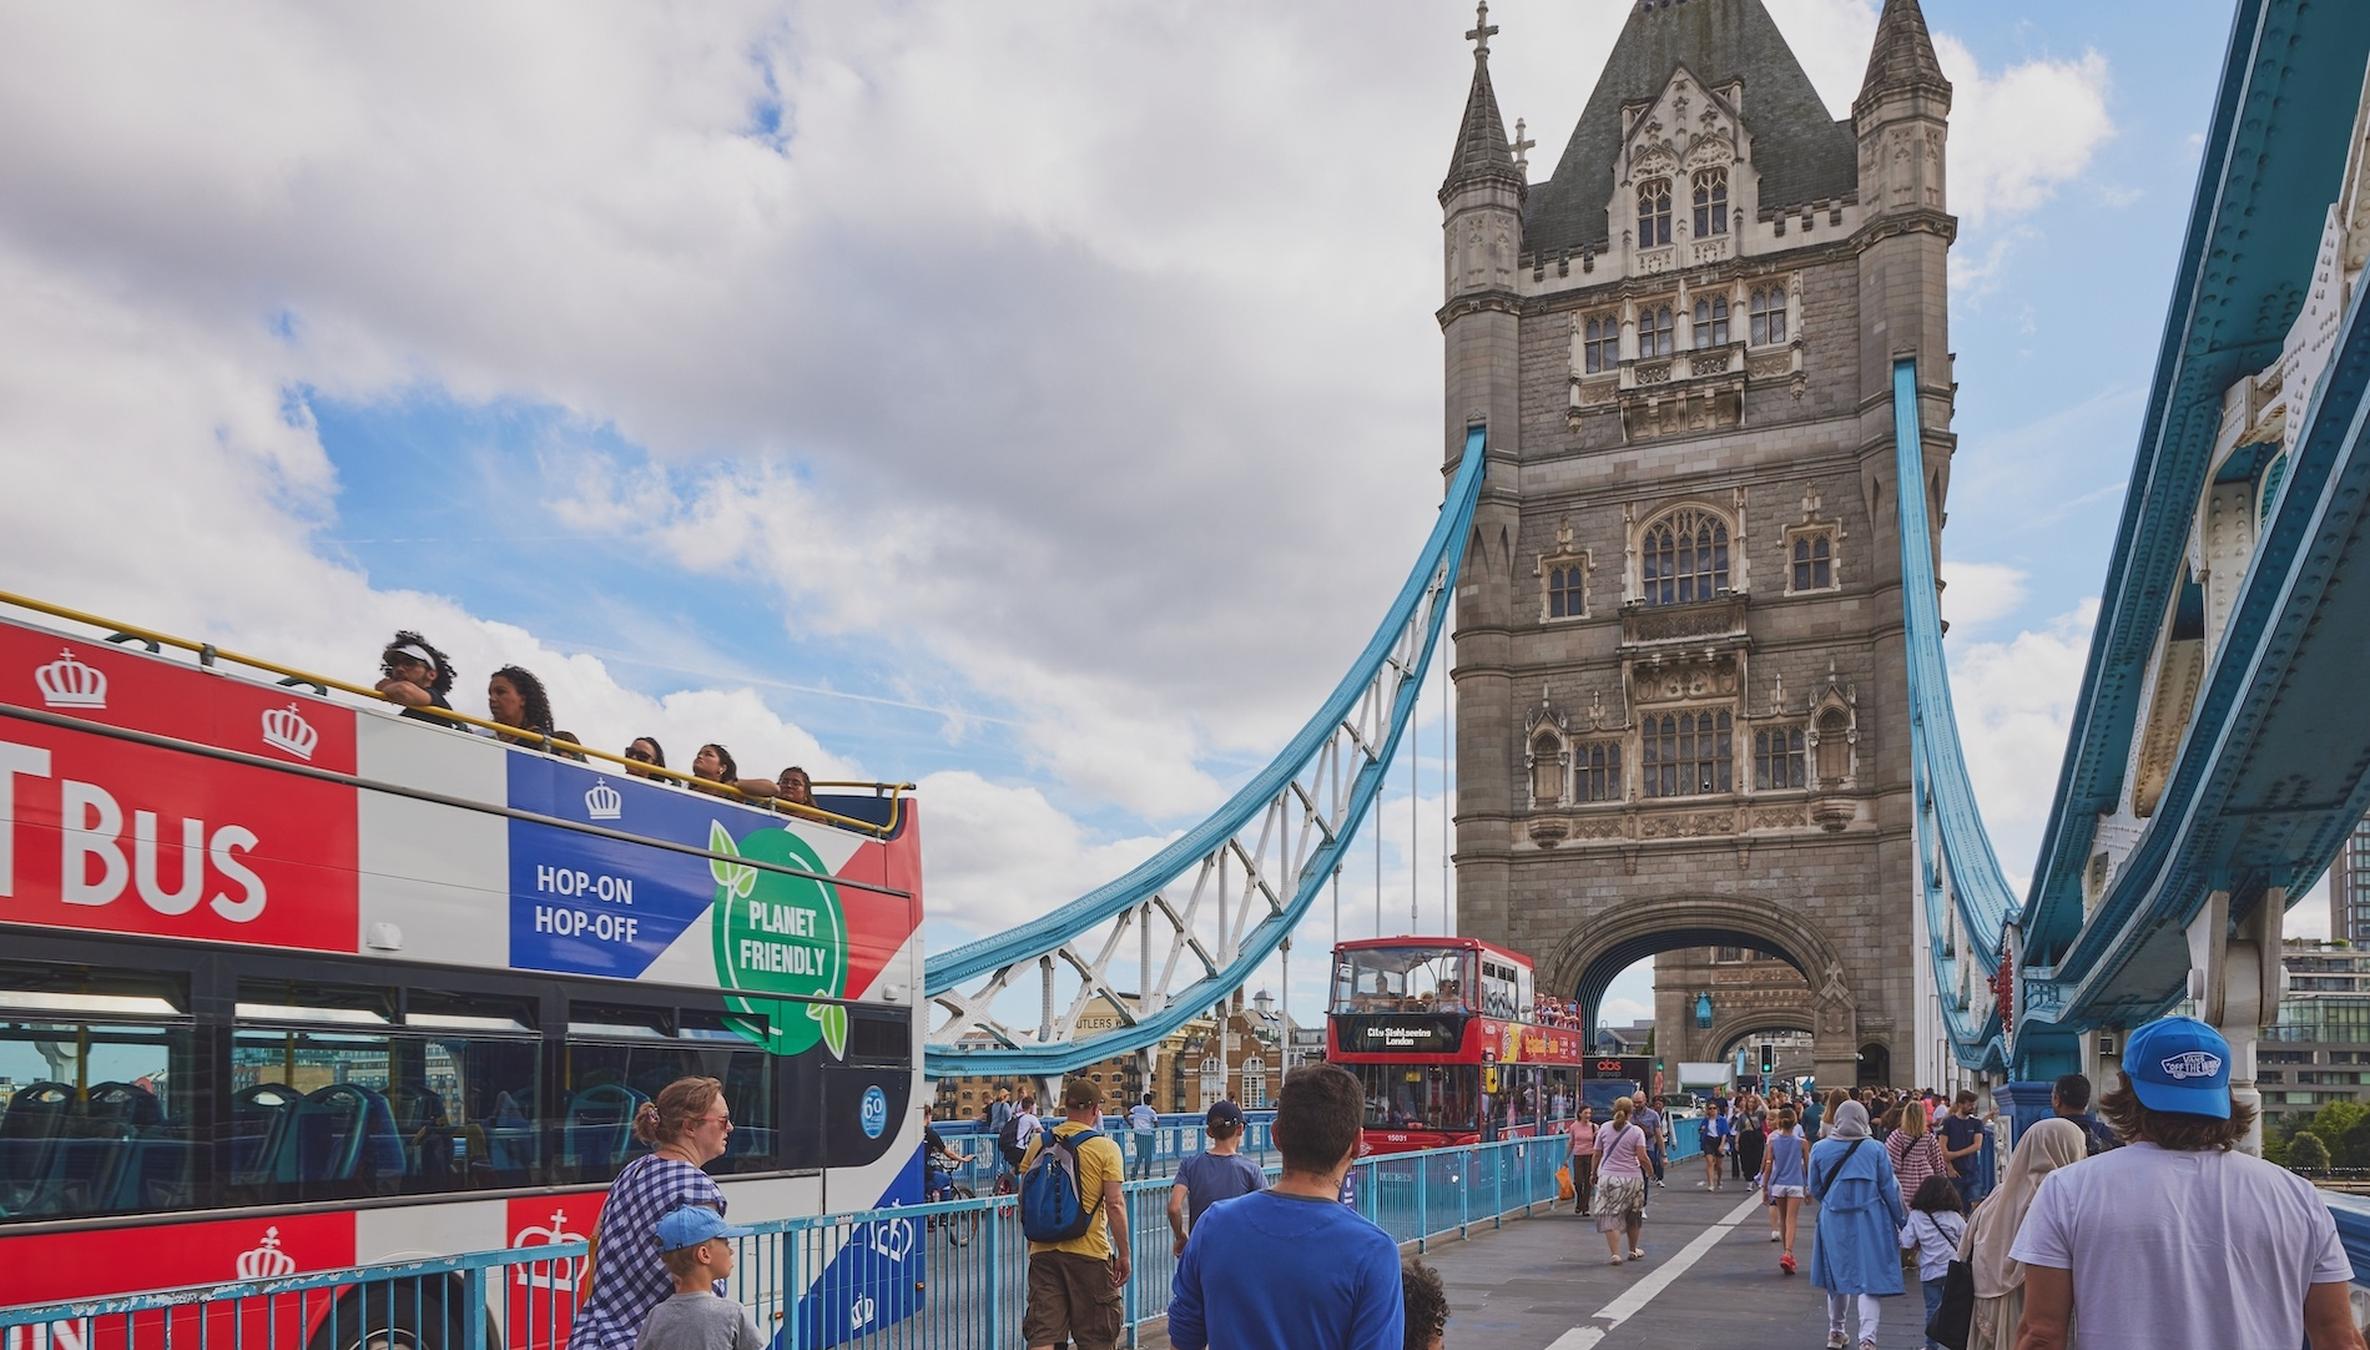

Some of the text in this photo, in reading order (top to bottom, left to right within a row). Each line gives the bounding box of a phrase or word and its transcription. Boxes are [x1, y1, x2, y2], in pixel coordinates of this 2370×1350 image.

[537, 865, 633, 904] HOP-ON
[535, 906, 638, 943] HOP-OFF
[749, 900, 816, 938] PLANET
[740, 940, 825, 977] FRIENDLY
[1076, 1018, 1112, 1029] UTLERS
[1367, 1028, 1384, 1037] City
[1386, 1037, 1414, 1045] London
[1387, 1134, 1407, 1142] 15031
